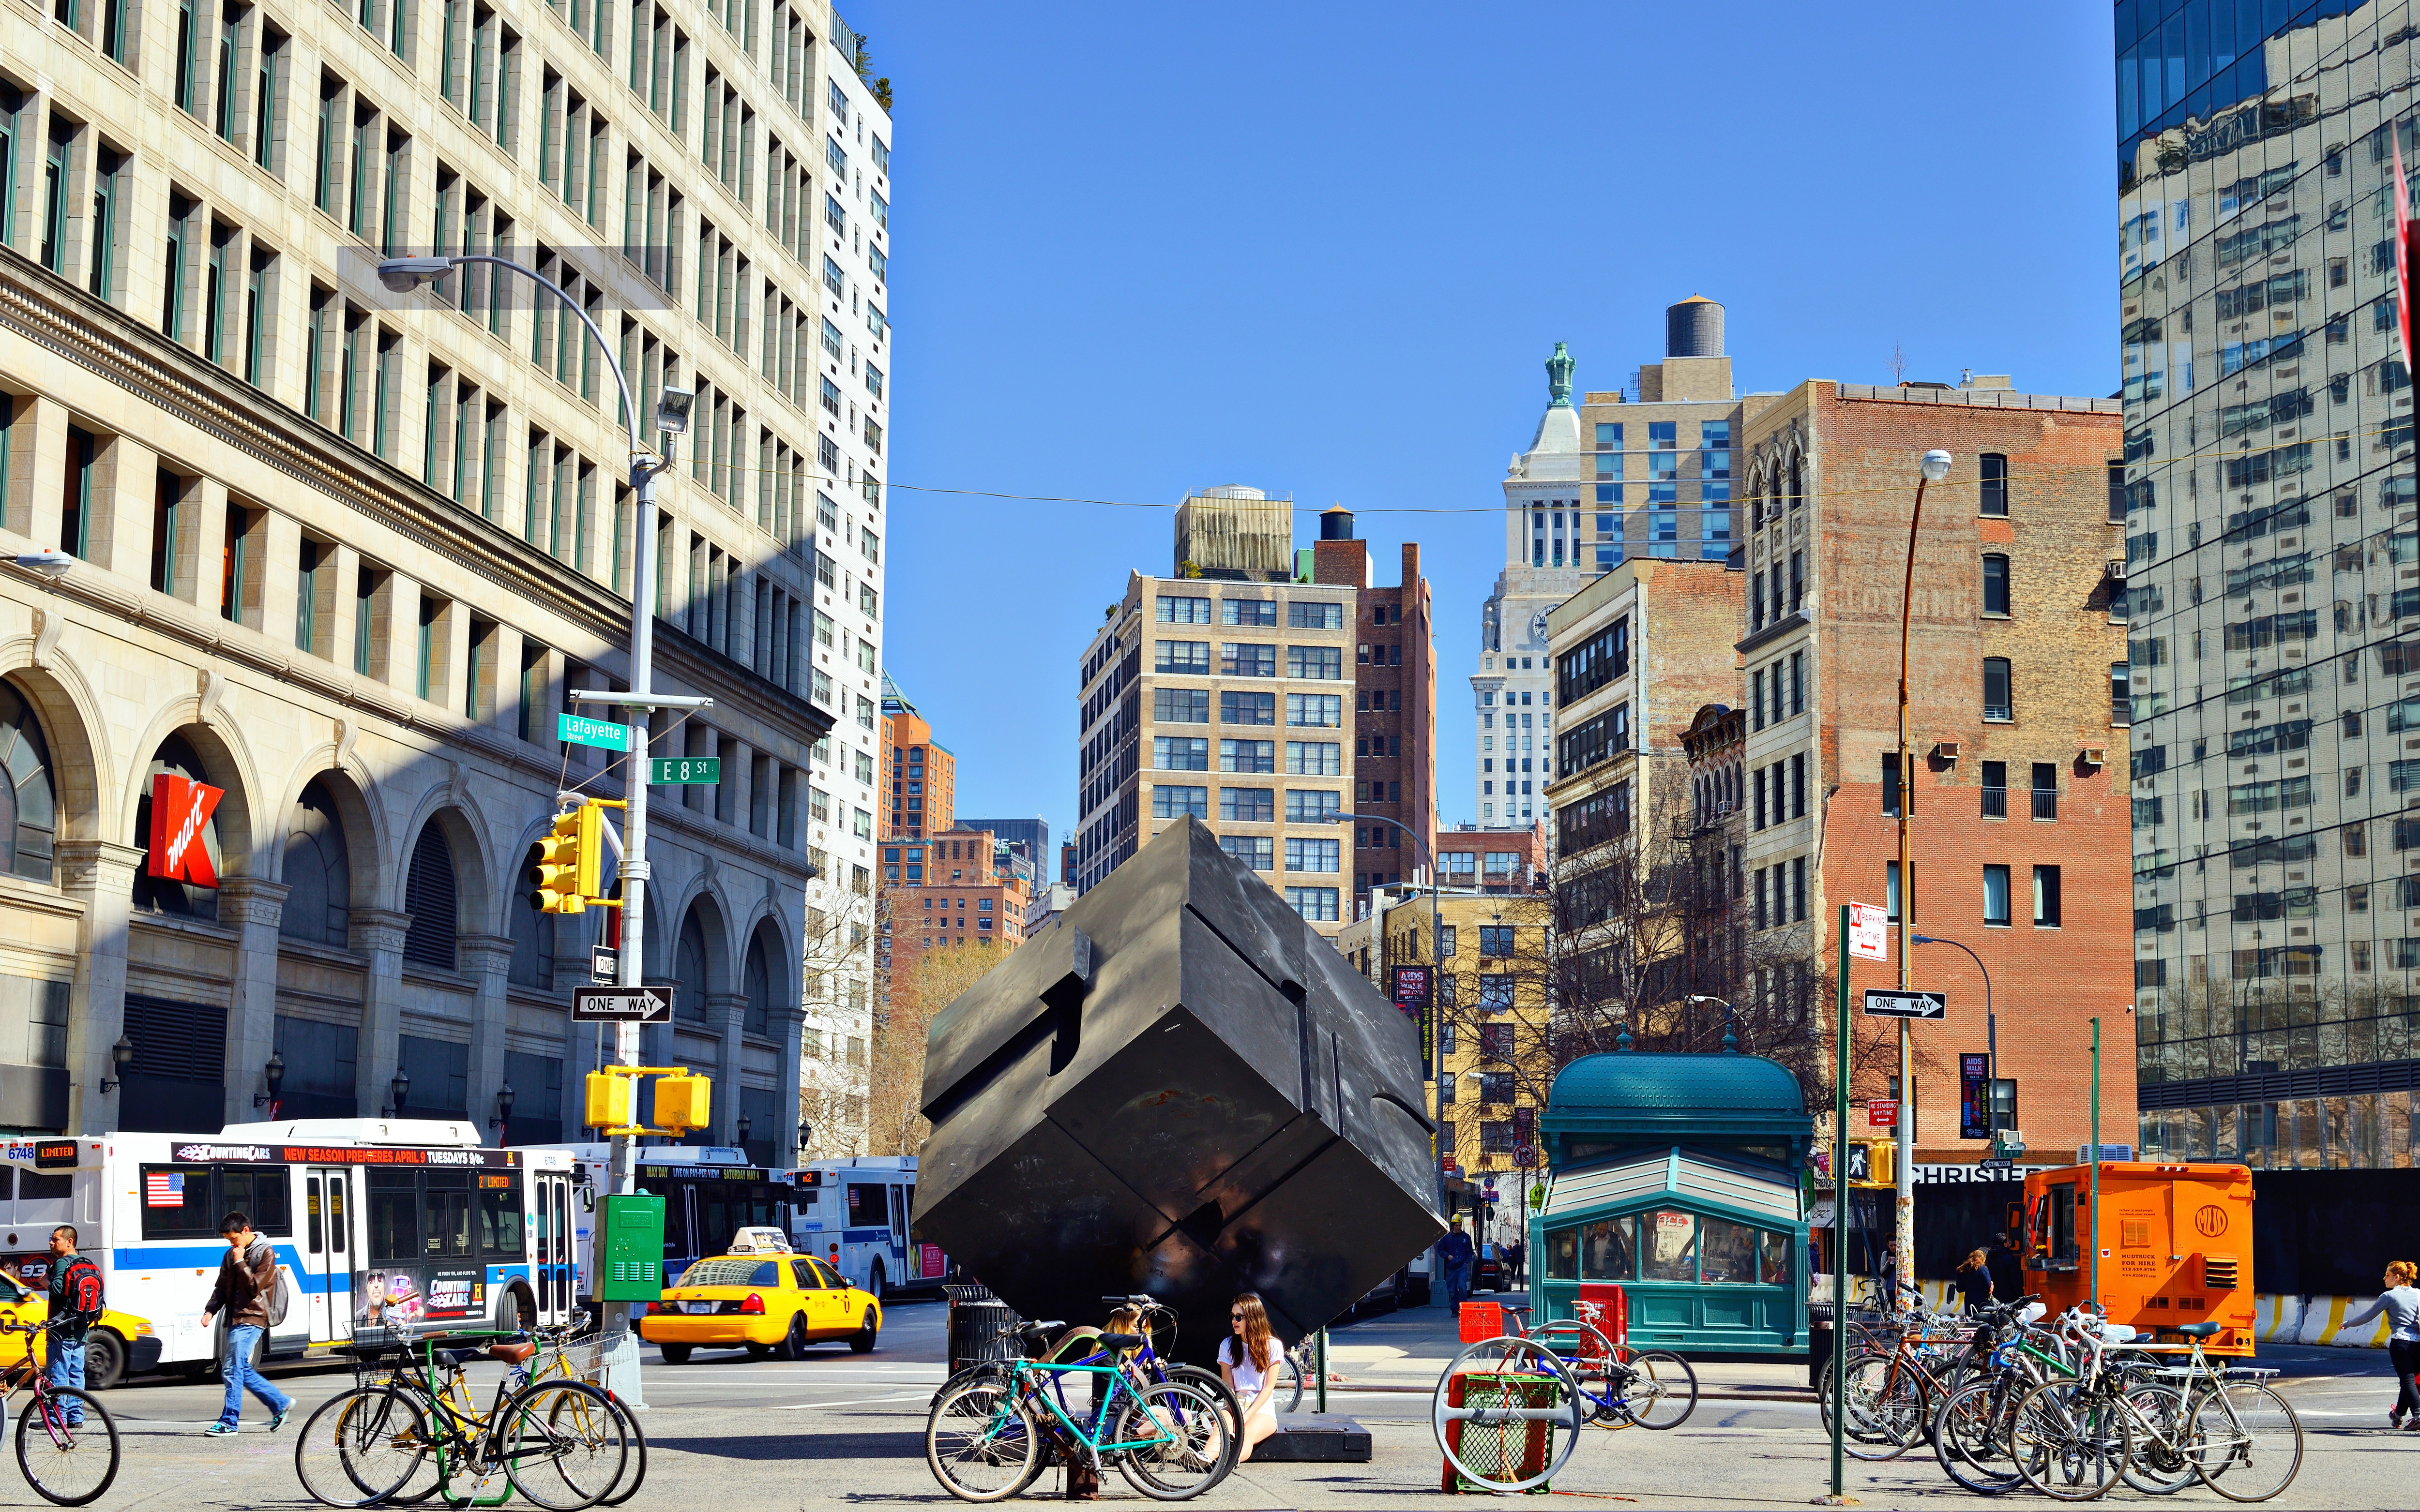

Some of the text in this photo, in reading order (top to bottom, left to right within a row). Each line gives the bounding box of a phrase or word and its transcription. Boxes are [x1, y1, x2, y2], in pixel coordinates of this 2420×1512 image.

[565, 717, 621, 740] Lafayette
[566, 732, 584, 742] Street
[664, 761, 707, 781] E 8 St
[1851, 906, 1885, 927] NO PARKING
[1856, 929, 1880, 943] ANYTIME
[600, 958, 614, 973] ONE
[1400, 972, 1424, 981] AIDS
[587, 998, 656, 1011] ONE WAY
[1875, 997, 1934, 1010] ONE WAY
[8, 1147, 34, 1159] 6748
[41, 1147, 74, 1157] LIMITED
[284, 1147, 307, 1161] NEW
[308, 1148, 345, 1162] SEASON
[394, 1151, 419, 1163] APRIL
[420, 1152, 425, 1163] 9
[426, 1152, 468, 1165] TUESDAYS
[469, 1153, 484, 1166] 9/8c
[544, 1156, 556, 1166] 6748
[646, 1166, 658, 1178] MAY
[658, 1167, 668, 1178] DAY
[673, 1168, 682, 1177] LIVE
[683, 1168, 689, 1178] ON
[724, 1168, 746, 1180] SATURDAY
[746, 1170, 756, 1180] MAY
[756, 1170, 760, 1181] 4
[487, 1176, 509, 1188] LIMITED
[1657, 1215, 1684, 1227] ACE
[2197, 1207, 2226, 1237] MUD
[926, 1250, 939, 1260] ORCHID
[430, 1279, 471, 1296] COUNTING
